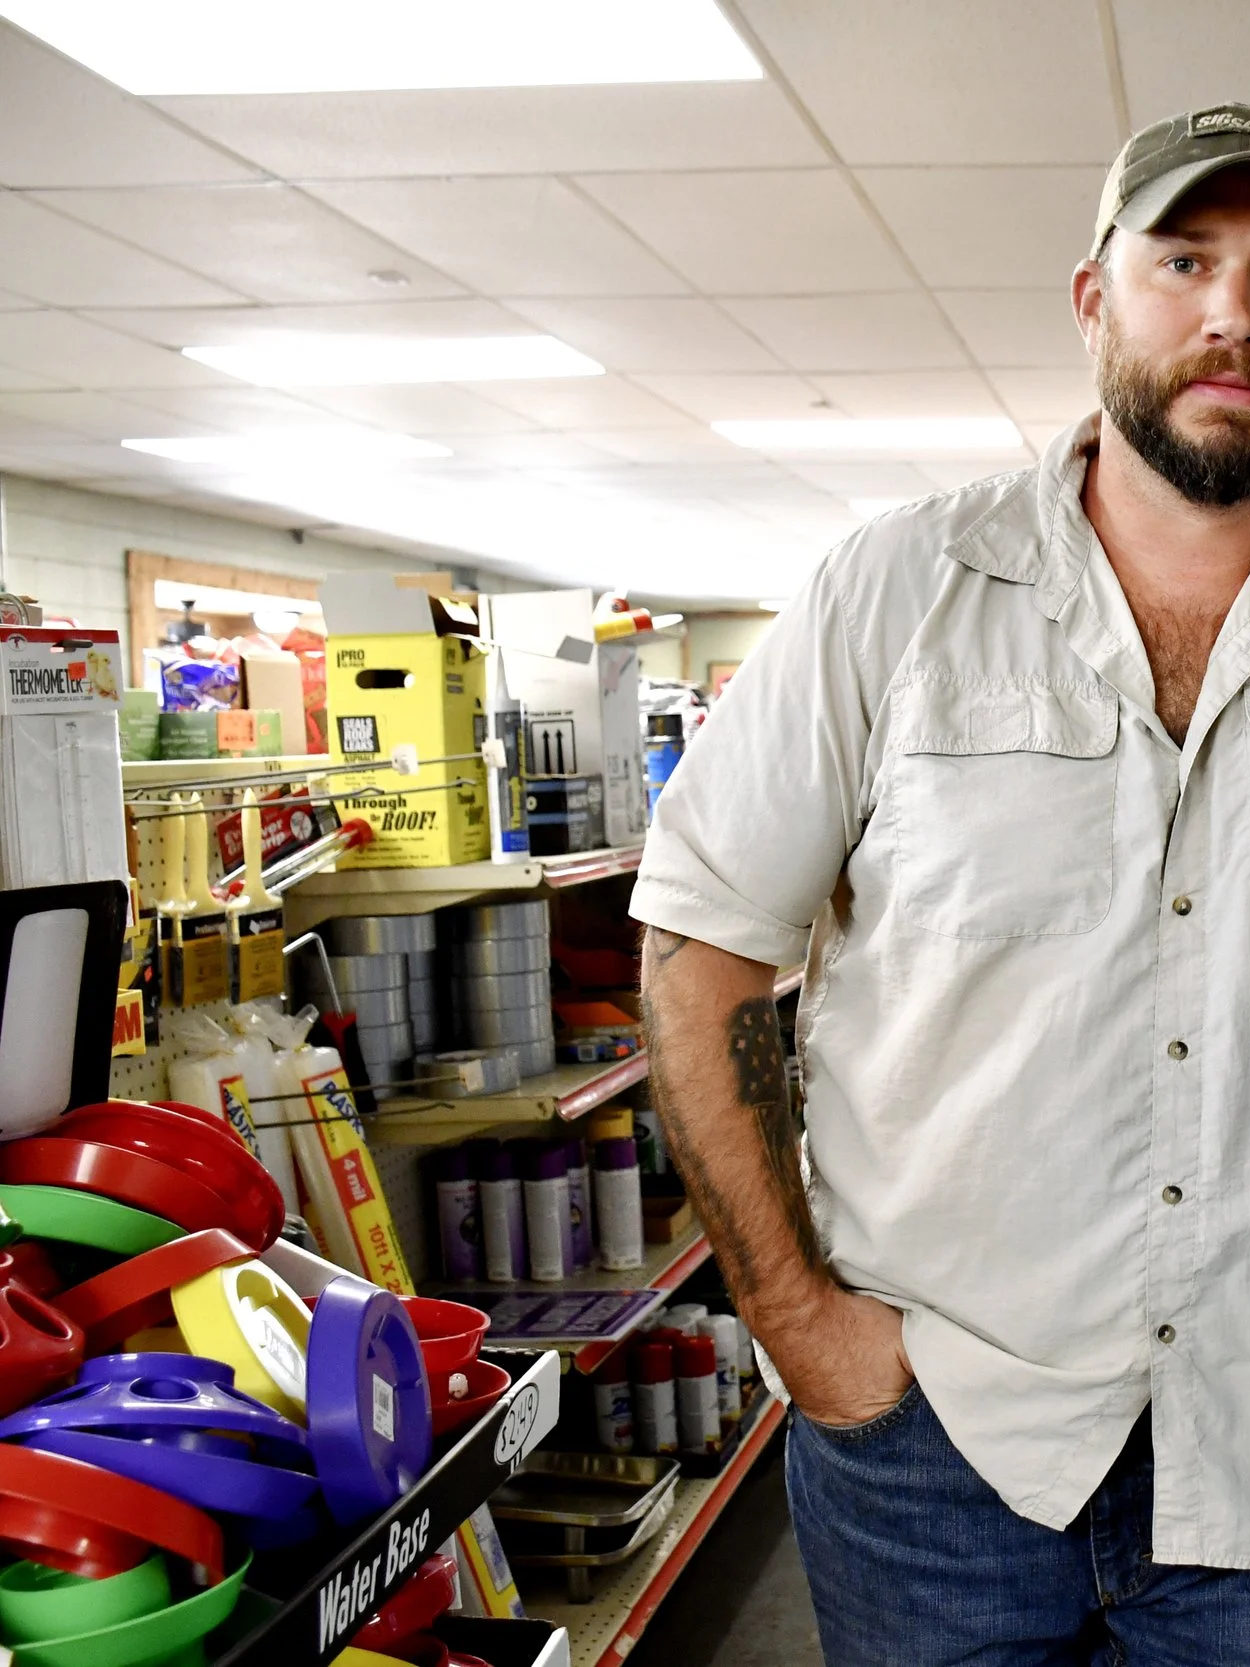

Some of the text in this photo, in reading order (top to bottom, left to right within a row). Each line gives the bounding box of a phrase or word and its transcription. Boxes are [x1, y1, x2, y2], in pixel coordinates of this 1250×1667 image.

[341, 649, 365, 661] PRO
[9, 668, 83, 695] THERMOMETER
[344, 794, 407, 811] Through
[381, 810, 437, 832] ROOF!
[343, 1158, 367, 1200] 4 mil
[319, 1507, 431, 1655] Water Base
